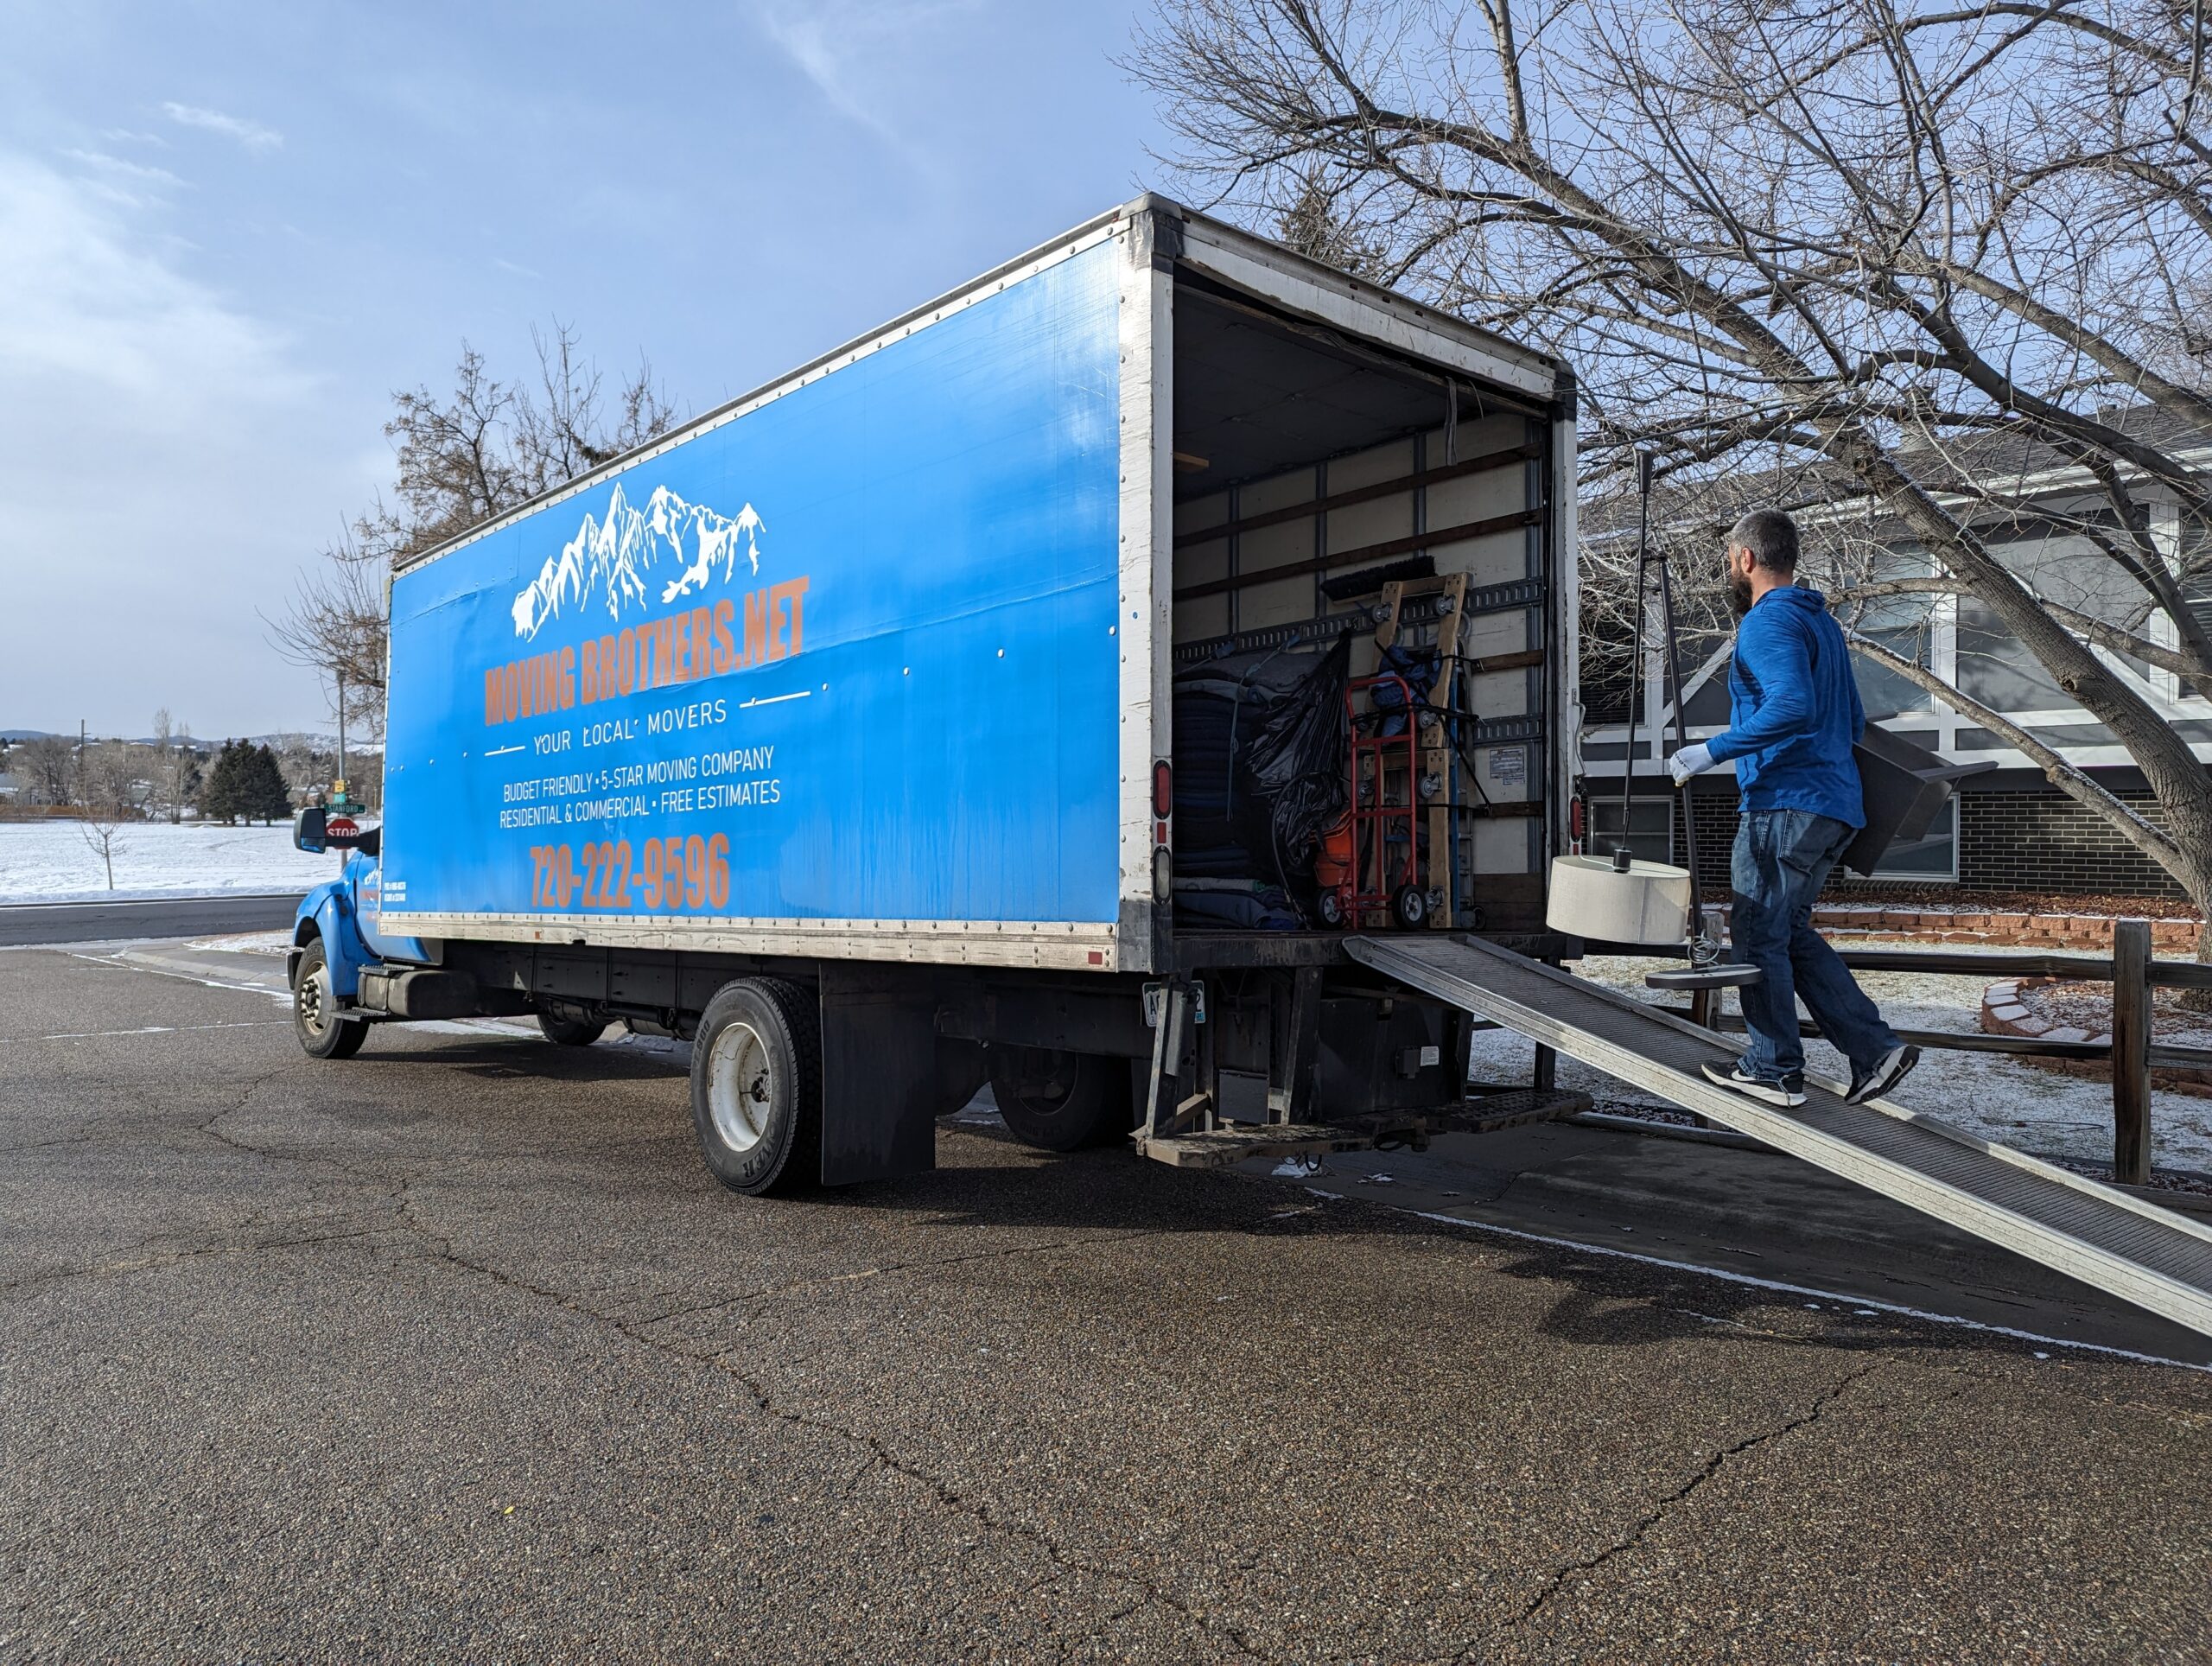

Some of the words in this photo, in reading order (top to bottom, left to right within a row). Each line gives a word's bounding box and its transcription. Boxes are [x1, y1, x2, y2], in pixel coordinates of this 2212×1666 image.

[485, 646, 575, 726] MOVING
[581, 576, 810, 704] BROTHERS.NET
[534, 731, 570, 754] YOUR
[583, 719, 634, 747] LOCAL
[648, 699, 727, 735] MOVERS
[504, 780, 541, 803] BUDGET
[543, 773, 593, 796] FRIENDLY
[601, 766, 644, 790] 5-STAR
[647, 756, 696, 784] MOVING
[702, 746, 774, 777] COMPANY
[327, 827, 358, 836] STOP
[328, 804, 359, 813] STANFORD
[500, 805, 563, 829] RESIDENTIAL
[565, 803, 572, 823] &
[575, 795, 650, 822] COMMERCIAL
[661, 790, 694, 813] FREE
[698, 779, 780, 810] ESTIMATES
[531, 833, 730, 909] 720-222-9596
